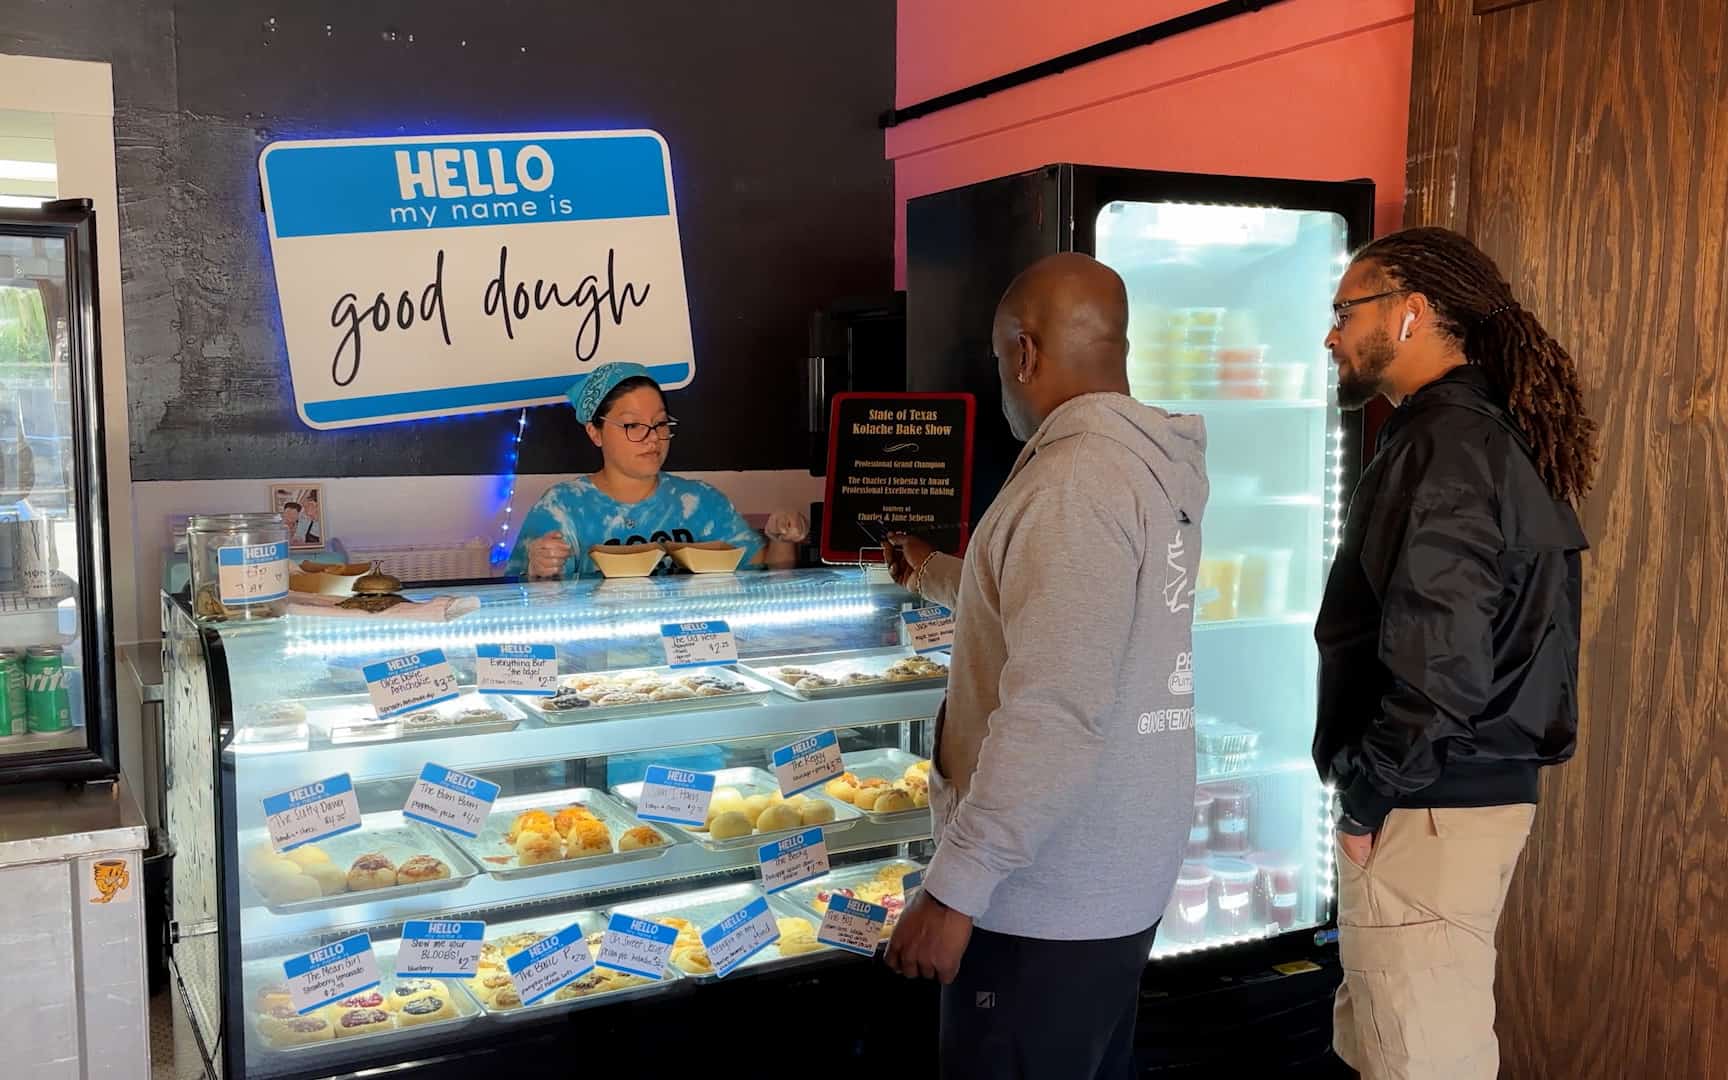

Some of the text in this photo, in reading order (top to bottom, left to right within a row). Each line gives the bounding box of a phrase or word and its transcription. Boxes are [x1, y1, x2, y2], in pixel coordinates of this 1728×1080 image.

[394, 144, 554, 200] HELLO
[391, 194, 573, 227] my name is
[331, 246, 650, 386] good dough
[868, 408, 938, 421] State of Texas
[852, 423, 952, 436] Kolache Bake Show
[246, 545, 277, 559] HELLO
[387, 655, 420, 672] HELLO
[1137, 710, 1166, 734] GIVE
[792, 737, 817, 755] HELLO
[444, 771, 477, 789] HELLO
[667, 770, 695, 784] HELLO
[289, 783, 325, 802] HELLO
[778, 834, 804, 851] HELLO
[847, 899, 871, 913] HELLO
[428, 922, 461, 934] HELLO
[630, 919, 659, 934] HELLO
[720, 910, 748, 932] HELLO
[309, 944, 345, 964] HELLO
[528, 936, 560, 959] HELLO
[303, 955, 361, 984] The Mean Girl
